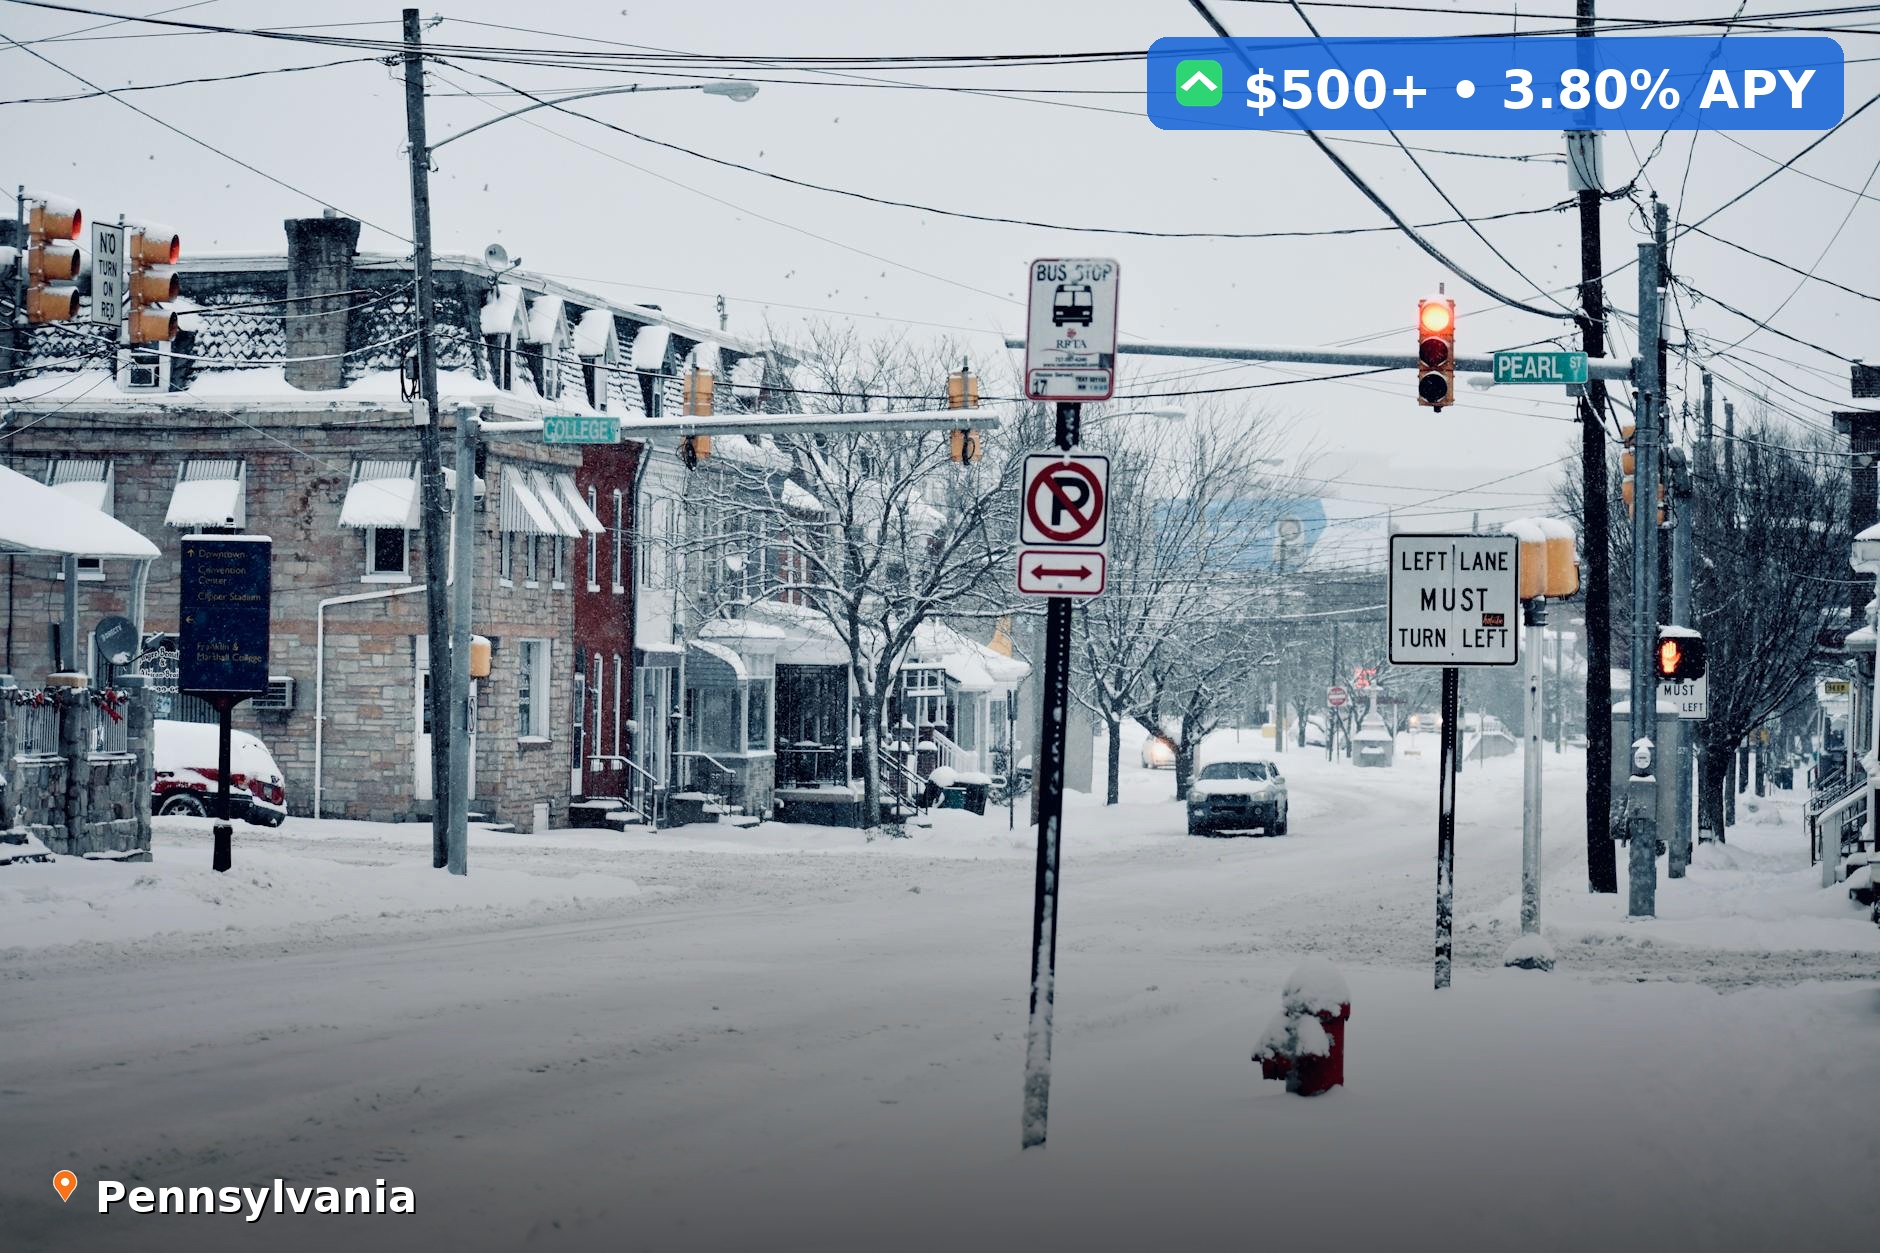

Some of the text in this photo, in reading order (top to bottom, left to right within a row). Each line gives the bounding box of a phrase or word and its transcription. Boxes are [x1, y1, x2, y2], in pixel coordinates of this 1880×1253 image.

[100, 231, 116, 255] NO
[99, 259, 117, 277] TURN
[1037, 264, 1113, 281] BUS STOP
[103, 281, 114, 297] ON
[101, 301, 114, 318] RED
[1499, 356, 1583, 379] PEARL ST
[545, 420, 609, 440] COLLEGE
[199, 549, 246, 559] Downtown
[1402, 552, 1508, 571] LEFT LANE
[198, 565, 246, 575] Convention
[198, 576, 227, 586] Center
[229, 592, 261, 602] Stadium
[1421, 588, 1488, 611] MUST
[233, 642, 240, 651] &
[1399, 628, 1508, 648] TURN LEFT
[1664, 685, 1695, 696] MUST
[1683, 703, 1703, 712] LEFT
